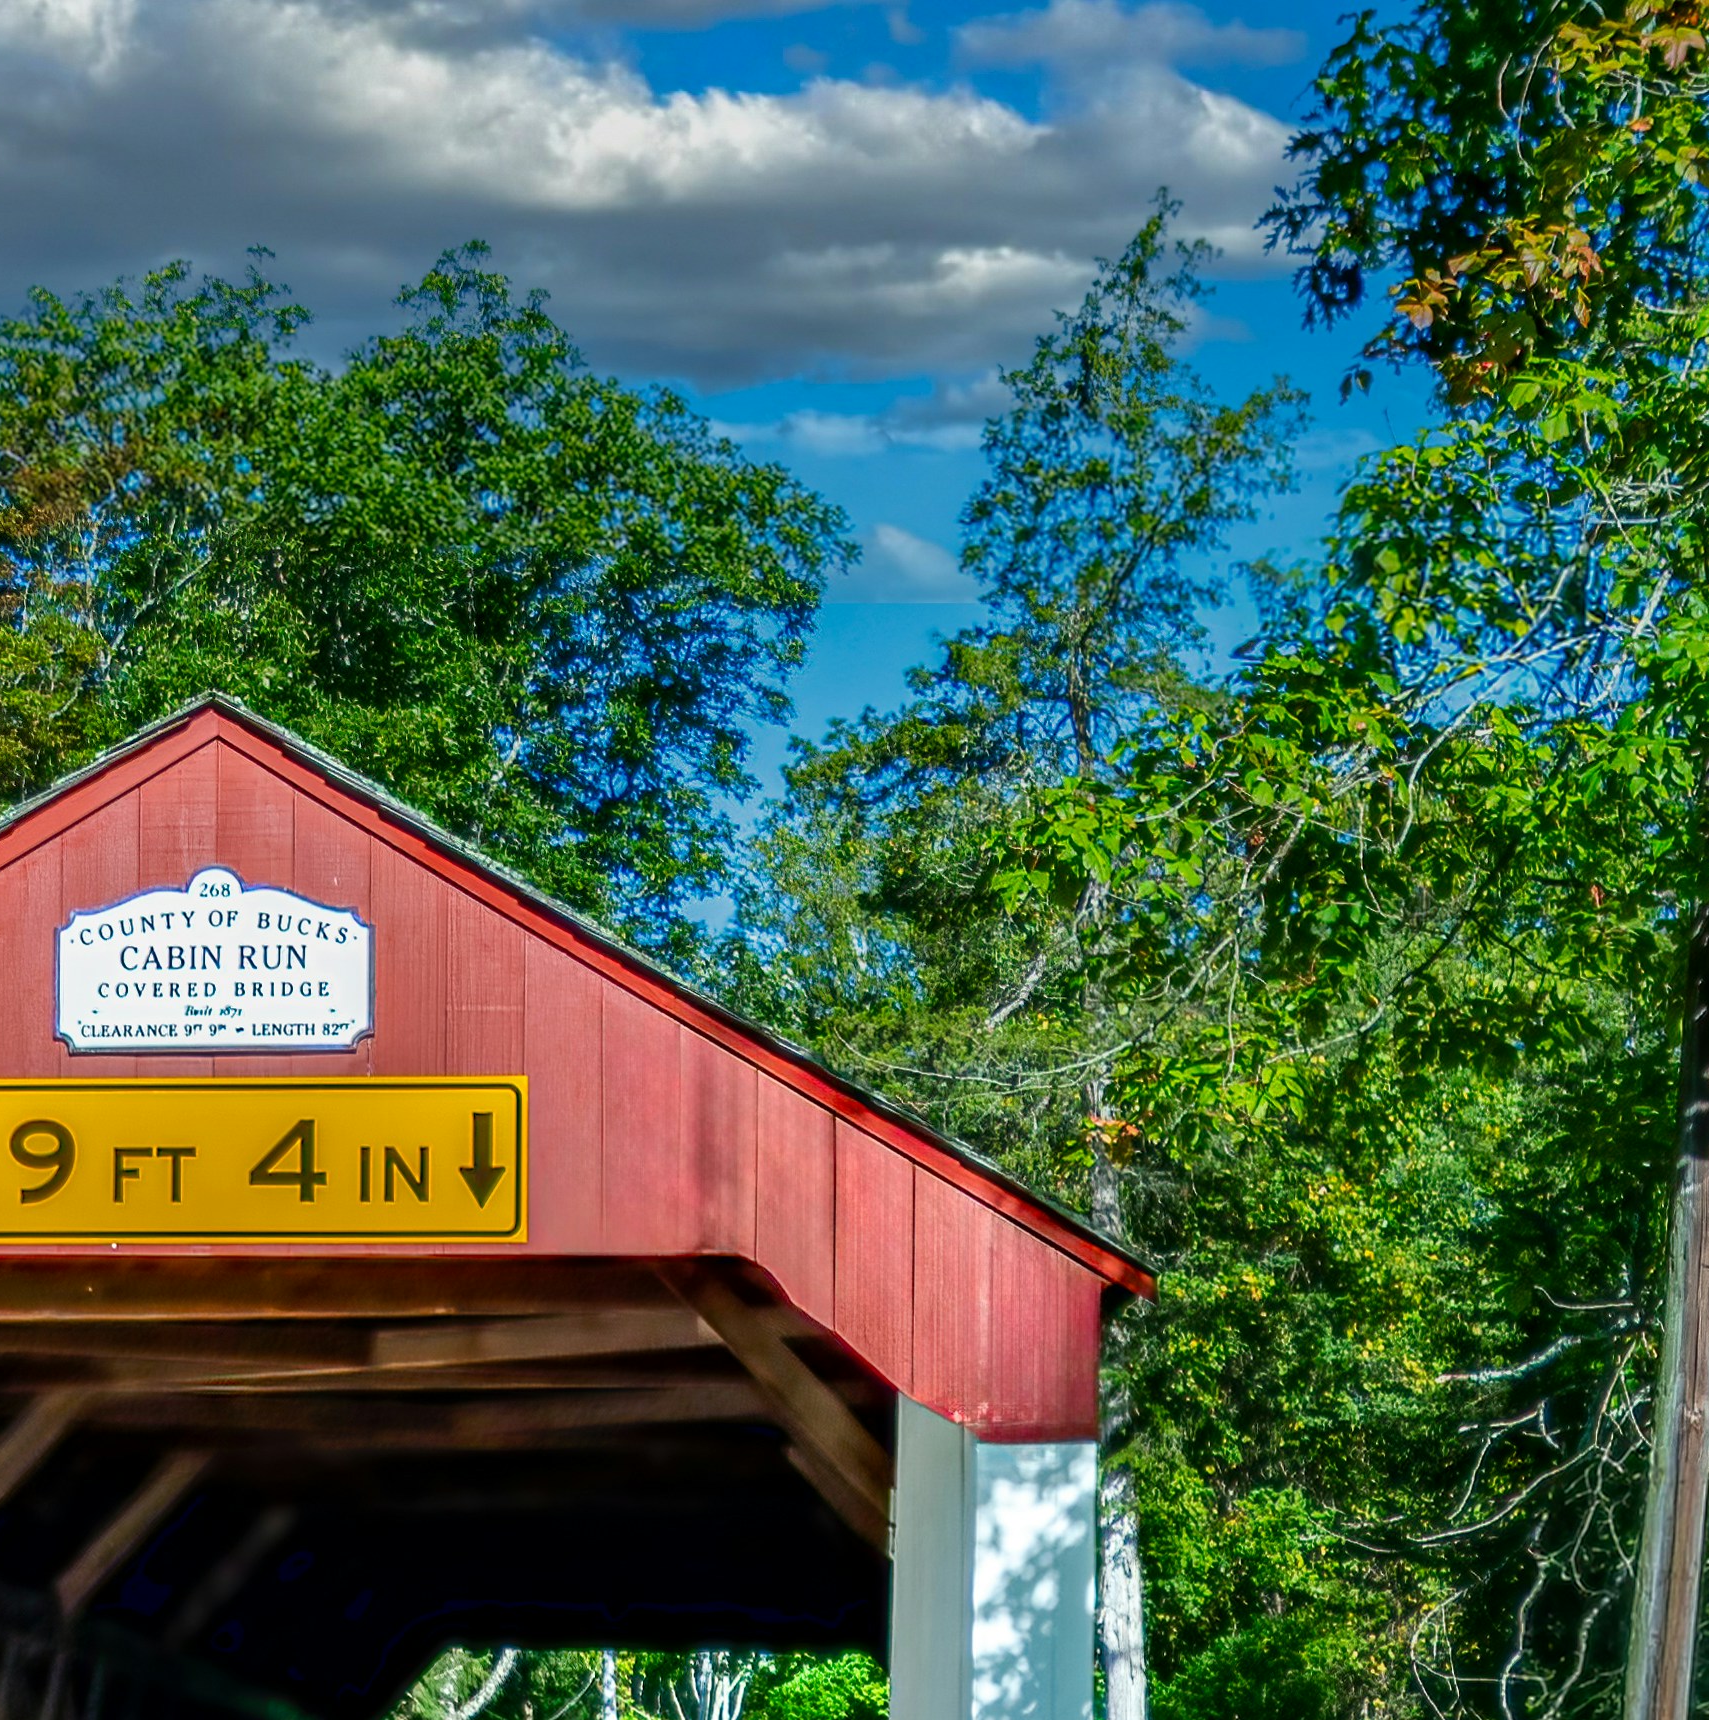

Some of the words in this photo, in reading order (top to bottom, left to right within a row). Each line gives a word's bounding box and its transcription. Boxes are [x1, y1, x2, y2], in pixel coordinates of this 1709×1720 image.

[199, 882, 231, 898] 268
[79, 910, 196, 946] COUNTY
[208, 909, 239, 928] OF
[257, 912, 349, 945] BUCKS
[119, 944, 222, 972] CABIN
[238, 944, 308, 971] RUN
[97, 982, 217, 999] COVERED
[233, 981, 331, 998] BRIDGE
[218, 1004, 244, 1019] 1871
[80, 1023, 179, 1038] CLEARANCE
[252, 1022, 316, 1037] LENGTH
[9, 1118, 78, 1205] 9
[113, 1146, 197, 1204] FT
[248, 1118, 329, 1204] 4
[359, 1145, 431, 1204] IN
